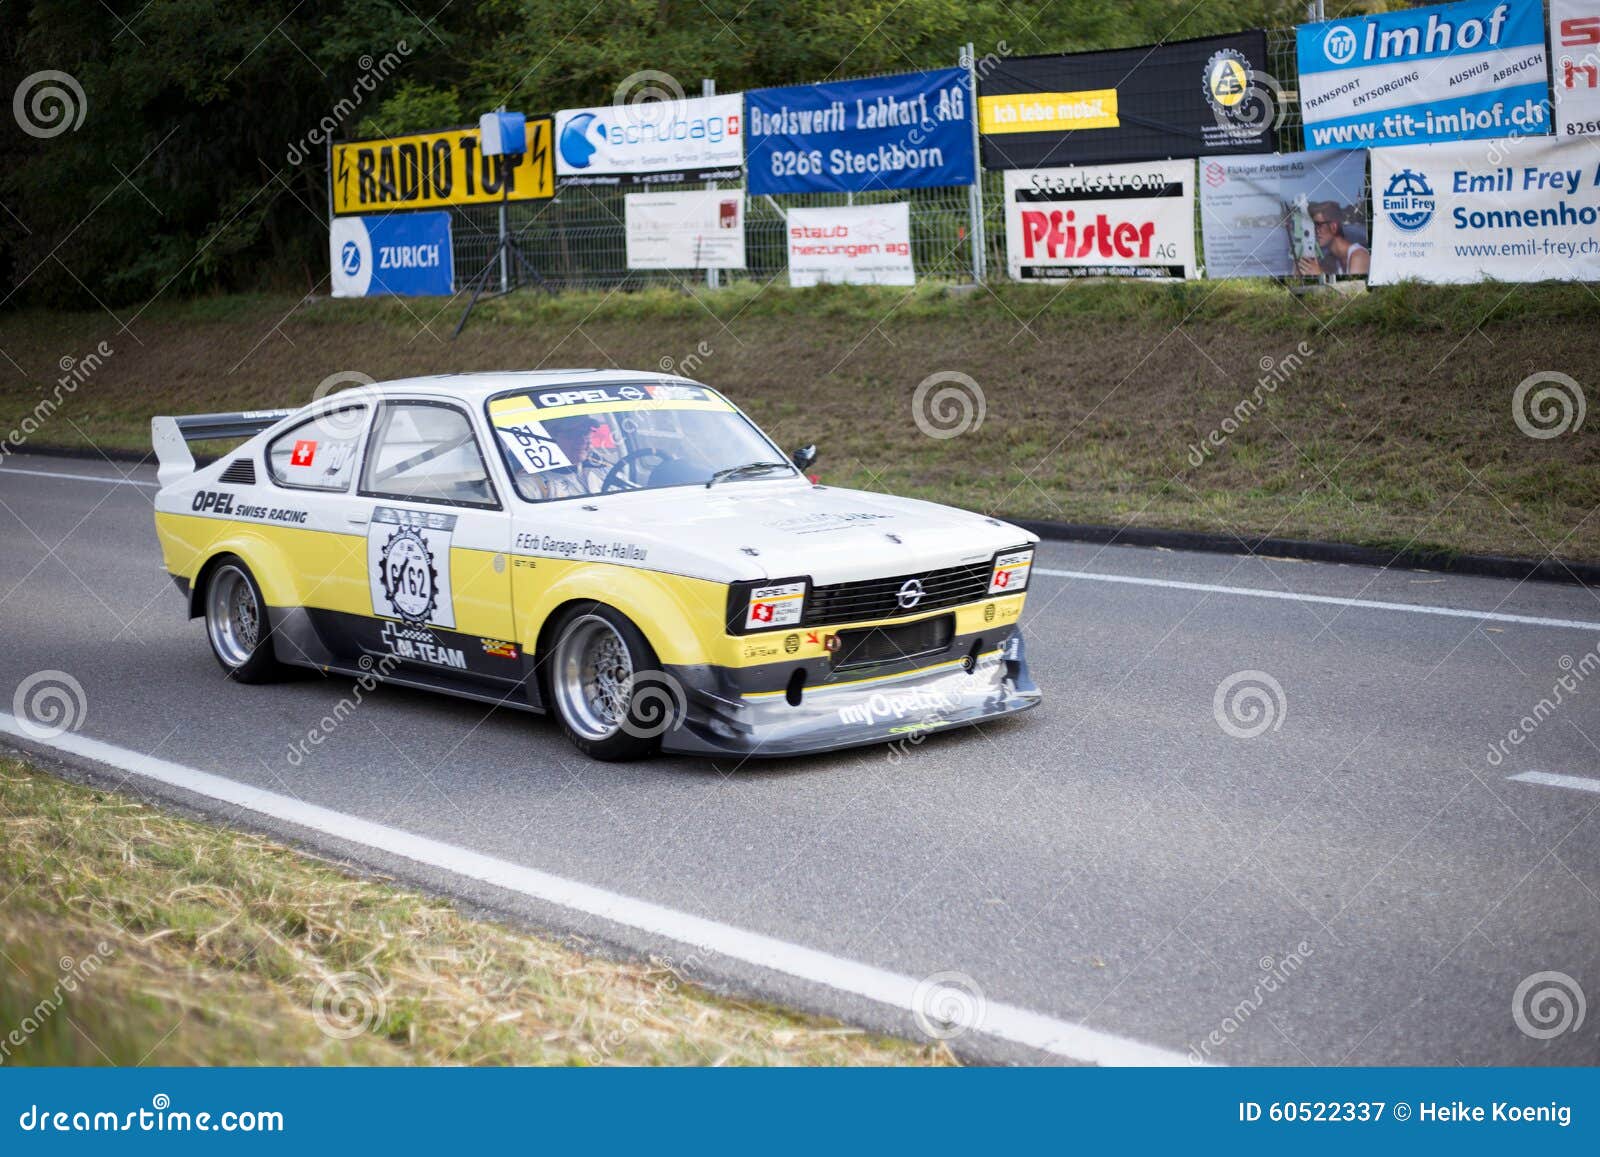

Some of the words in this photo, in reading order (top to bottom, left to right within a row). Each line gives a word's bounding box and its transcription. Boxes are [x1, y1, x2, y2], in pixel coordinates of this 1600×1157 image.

[1363, 5, 1509, 60] Imhof
[1449, 62, 1490, 86] AUSHUB
[1493, 54, 1543, 83] ABBRUCH
[939, 86, 965, 120] AG
[1305, 79, 1361, 110] TRANSPORT
[1353, 72, 1419, 106] ENTSORGUNG
[994, 104, 1017, 123] Ich
[1019, 102, 1054, 121] lebe
[1312, 99, 1545, 146] www.tit-imhof.ch
[610, 114, 723, 144] schubag
[358, 139, 453, 204] RADIO
[771, 150, 823, 176] 8266
[830, 144, 943, 175] Steckborn
[1030, 170, 1165, 195] Starkstrom
[1453, 167, 1513, 193] Emil
[1523, 166, 1582, 195] Frey
[1383, 198, 1409, 210] Emil
[1412, 198, 1435, 211] Frey
[791, 225, 848, 239] staub
[1021, 209, 1155, 259] Pfister
[1156, 243, 1176, 259] AG
[380, 244, 439, 269] ZURICH
[791, 243, 880, 257] heizungen
[885, 242, 909, 256] ag
[538, 389, 621, 407] OPEL
[524, 446, 560, 468] 62
[192, 490, 235, 514] OPEL
[235, 504, 267, 519] SWISS
[268, 508, 307, 523] RACING
[408, 566, 427, 598] 62
[756, 588, 787, 598] OPEL
